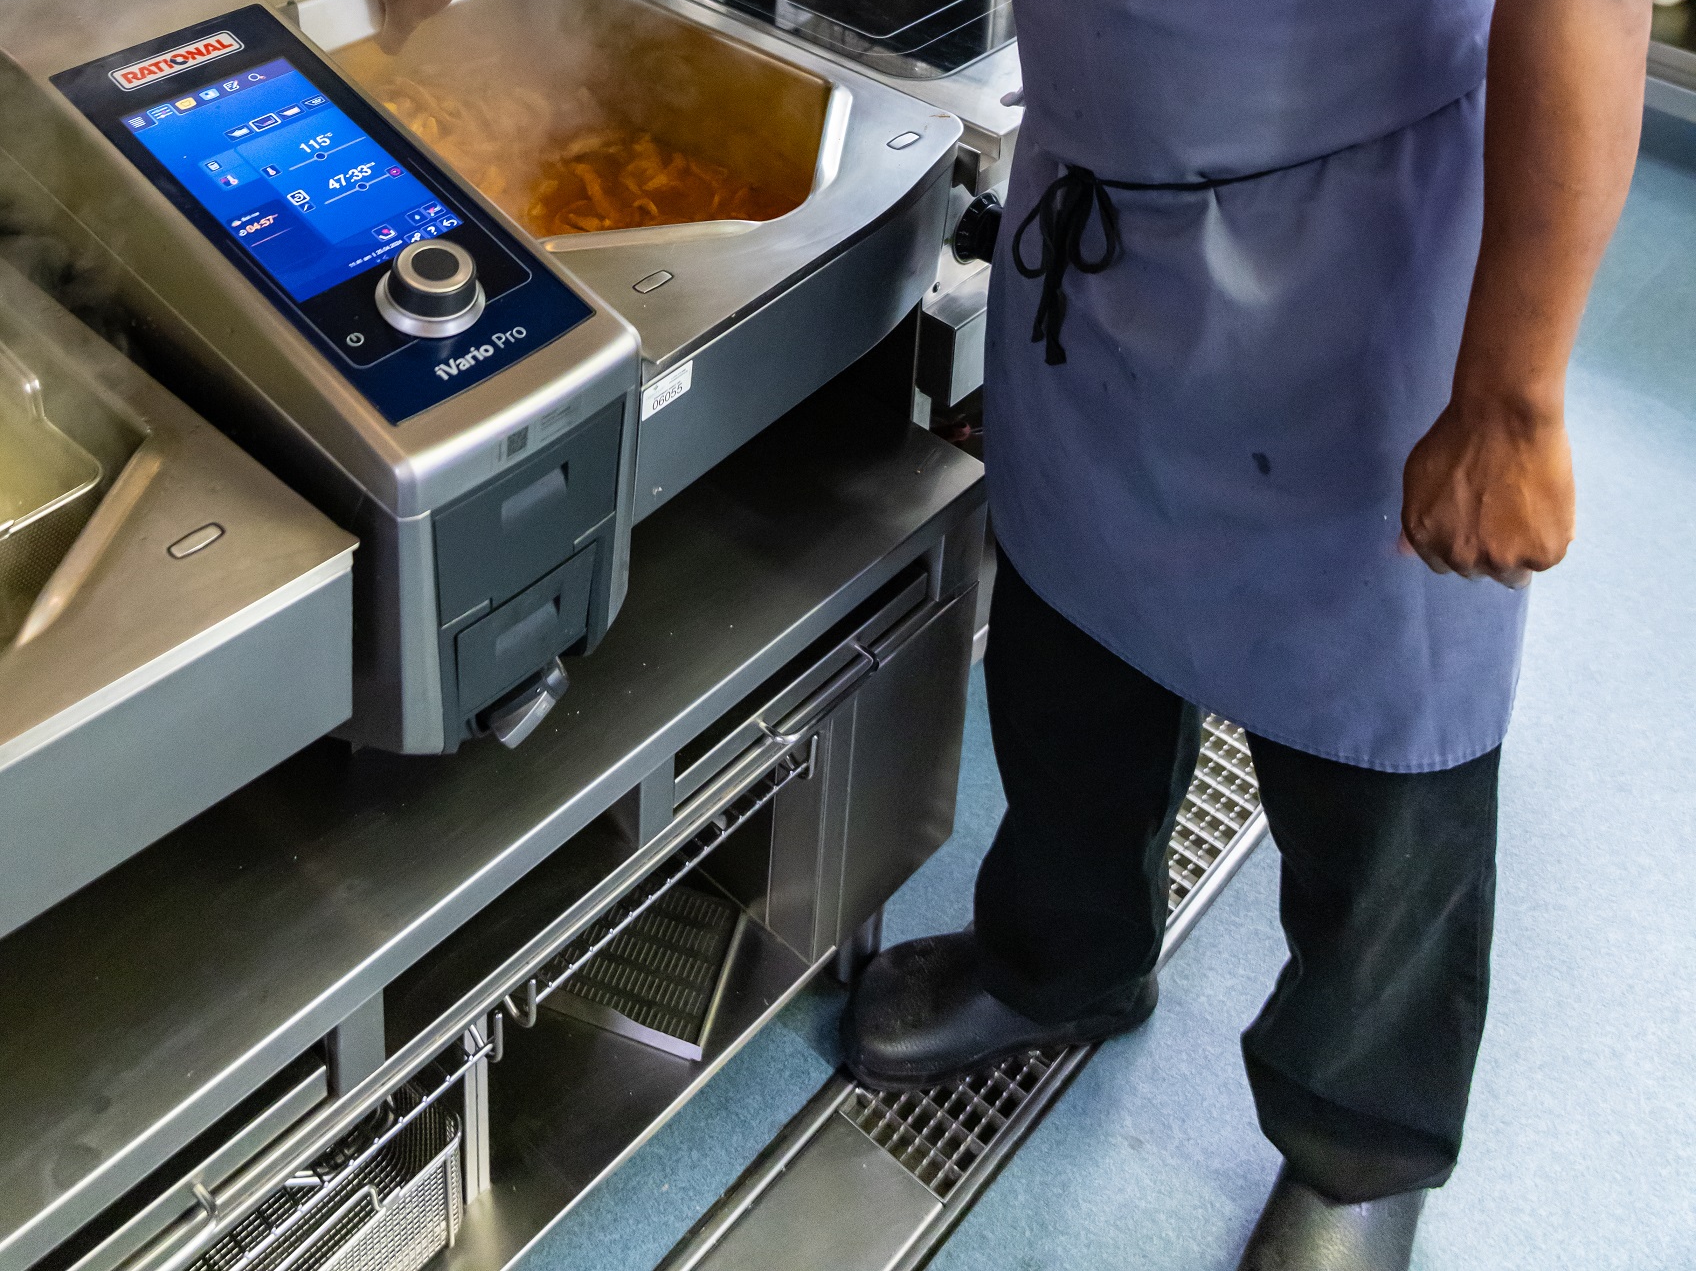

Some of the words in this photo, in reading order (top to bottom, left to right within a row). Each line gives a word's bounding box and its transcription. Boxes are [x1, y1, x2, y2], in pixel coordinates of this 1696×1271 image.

[121, 39, 234, 84] RATIONAL
[434, 344, 494, 381] iVario
[491, 326, 527, 349] Pro
[652, 382, 683, 411] 06055
